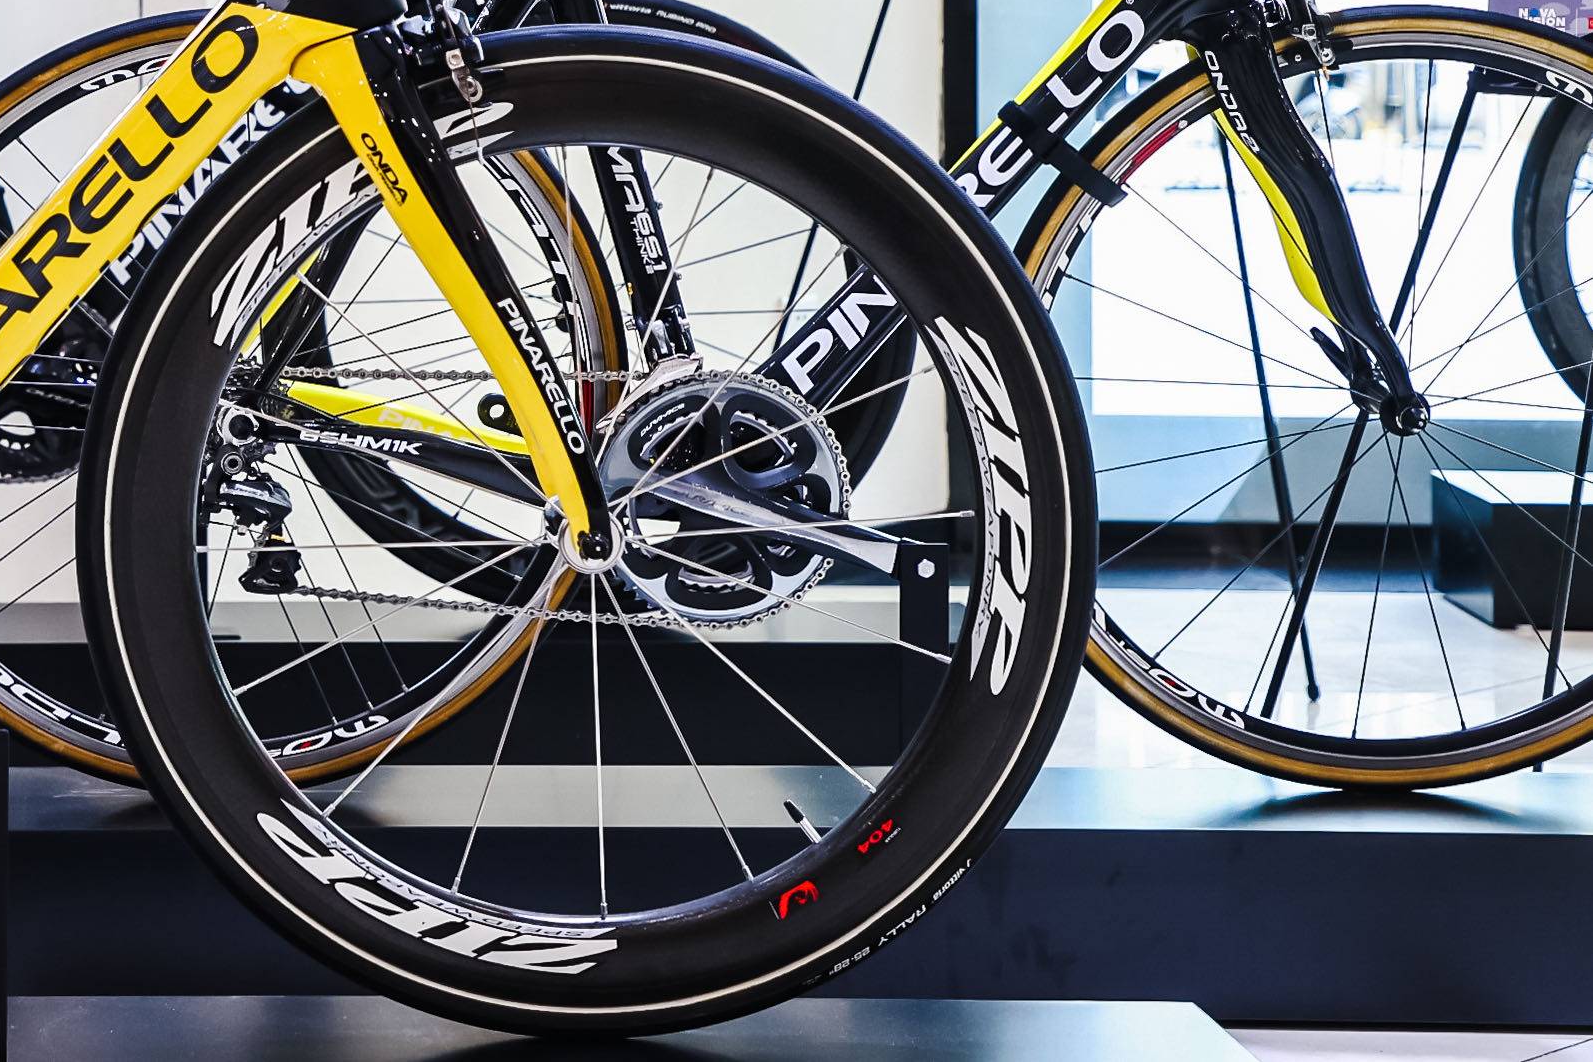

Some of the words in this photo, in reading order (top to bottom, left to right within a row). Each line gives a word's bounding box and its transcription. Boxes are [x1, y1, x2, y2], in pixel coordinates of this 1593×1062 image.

[360, 131, 409, 205] ONDA
[495, 297, 586, 456] PINARELLO
[934, 316, 1034, 696] ZIPP
[256, 812, 618, 975] ZIPP
[856, 817, 895, 855] 404
[878, 903, 928, 948] RALLY
